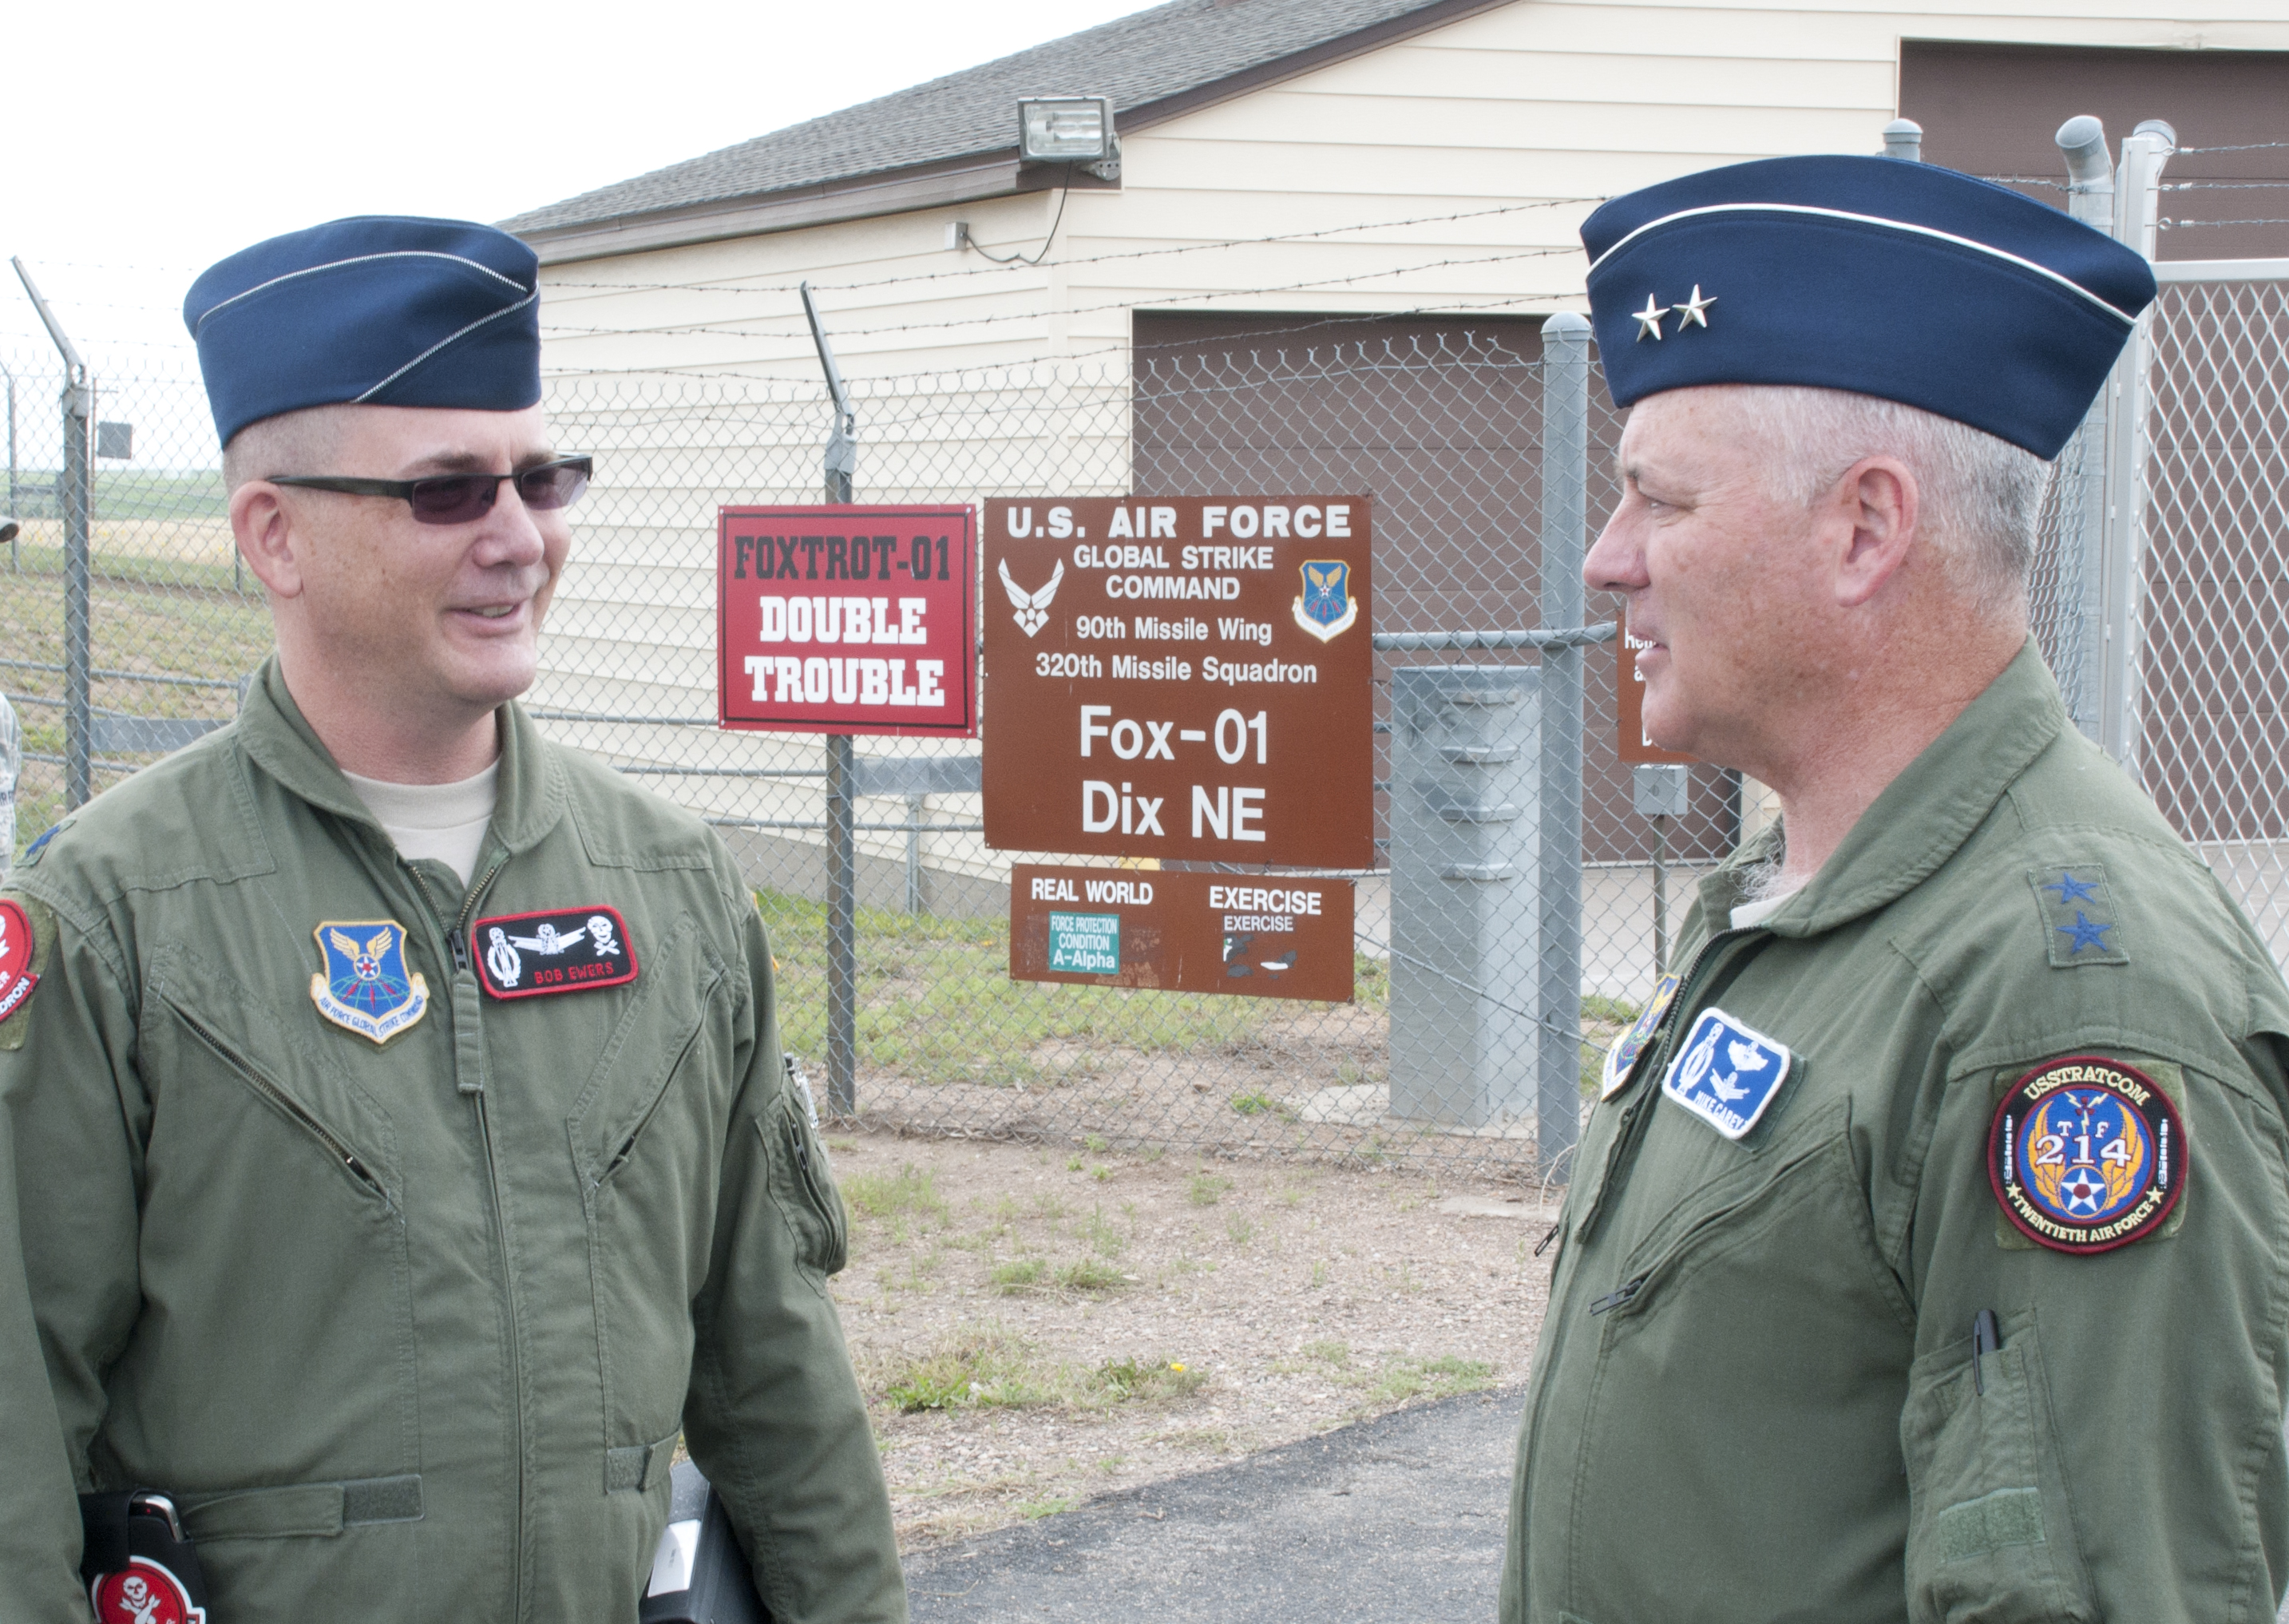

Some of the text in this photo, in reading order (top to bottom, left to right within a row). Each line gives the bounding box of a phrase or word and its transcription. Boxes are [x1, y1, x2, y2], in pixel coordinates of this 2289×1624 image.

[1007, 505, 1352, 539] U.S. AIR FORCE
[734, 536, 950, 580] FOXTROT-01
[1073, 545, 1274, 570] GLOBAL STRIKE
[1106, 574, 1241, 600] COMMAND
[759, 596, 927, 645] DOUBLE
[1076, 615, 1126, 640] 90th
[1135, 616, 1209, 641] Missile
[1218, 617, 1273, 647] Wing
[744, 656, 945, 707] TROUBLE
[1036, 652, 1318, 687] 320th Missile Squadron
[1079, 704, 1268, 765] Fox-01
[1082, 779, 1266, 842] Dix NE
[1032, 877, 1154, 905] REAL WORLD
[1210, 885, 1322, 916] EXERCISE
[1051, 915, 1118, 935] FORCE PROTECTION
[1223, 915, 1294, 933] EXERCISE
[1058, 932, 1111, 952] CONDITION
[534, 961, 615, 984] BOB EWERS
[1052, 949, 1115, 971] A-Alpha
[330, 1007, 350, 1024] FORCE
[2022, 1065, 2152, 1107] USSTRATCOM
[1693, 1090, 1744, 1131] MIKE CAREY
[2057, 1120, 2109, 1139] T F
[2035, 1134, 2133, 1168] 214
[2014, 1194, 2154, 1242] TWENTIETH AIR FORCE
